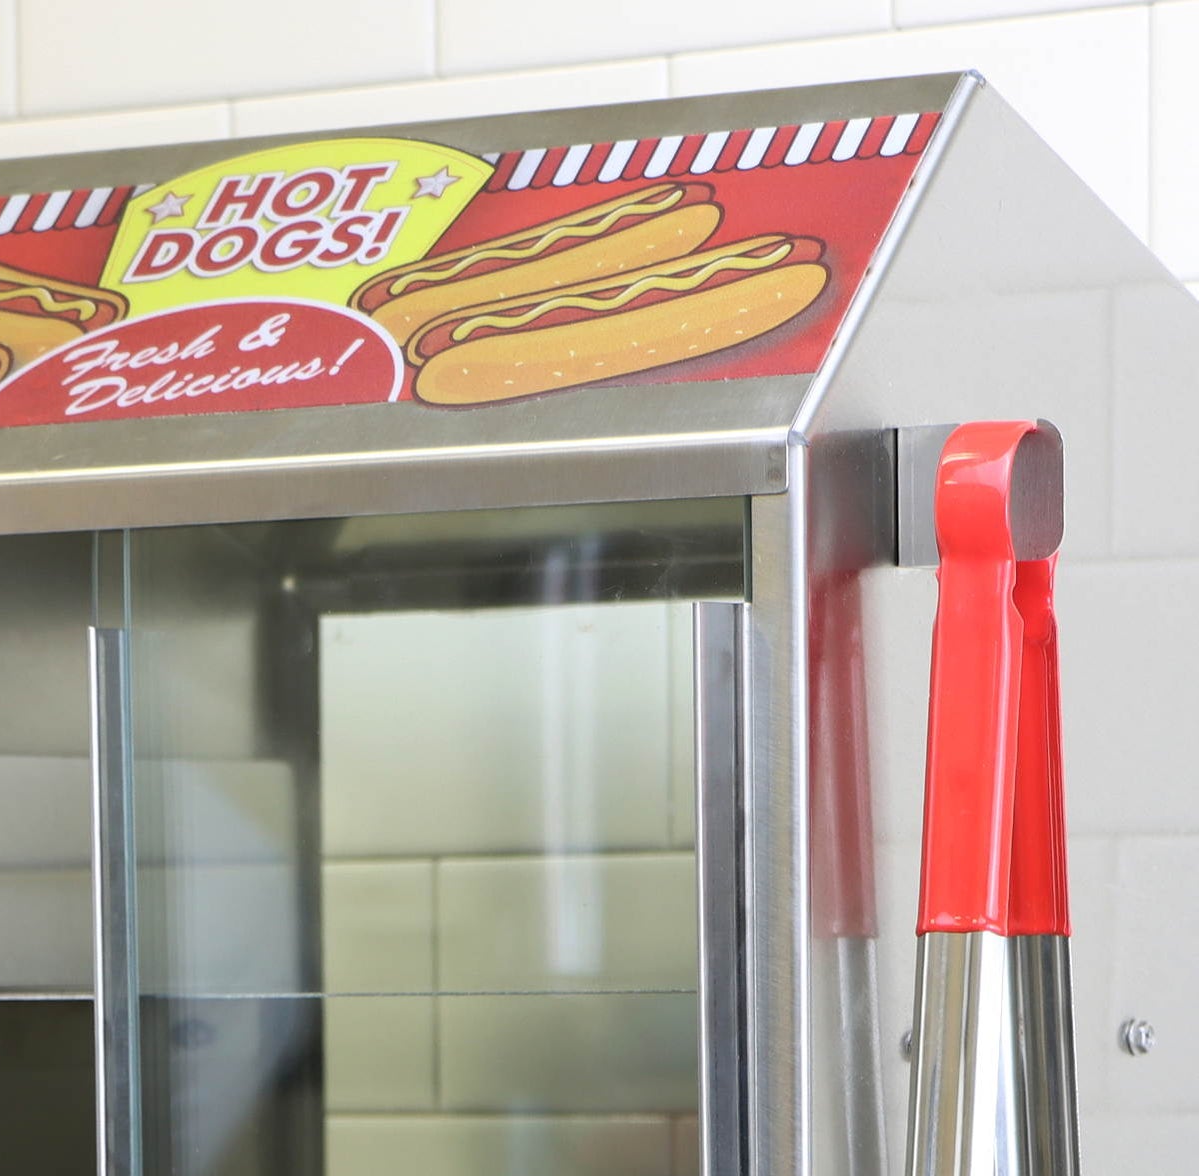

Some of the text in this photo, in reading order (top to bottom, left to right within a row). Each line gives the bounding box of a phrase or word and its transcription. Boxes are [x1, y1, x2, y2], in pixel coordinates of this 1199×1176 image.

[199, 162, 397, 228] HOT
[124, 208, 408, 281] DOGS!
[61, 313, 291, 386] Fresh &
[64, 338, 365, 416] Delicious!
